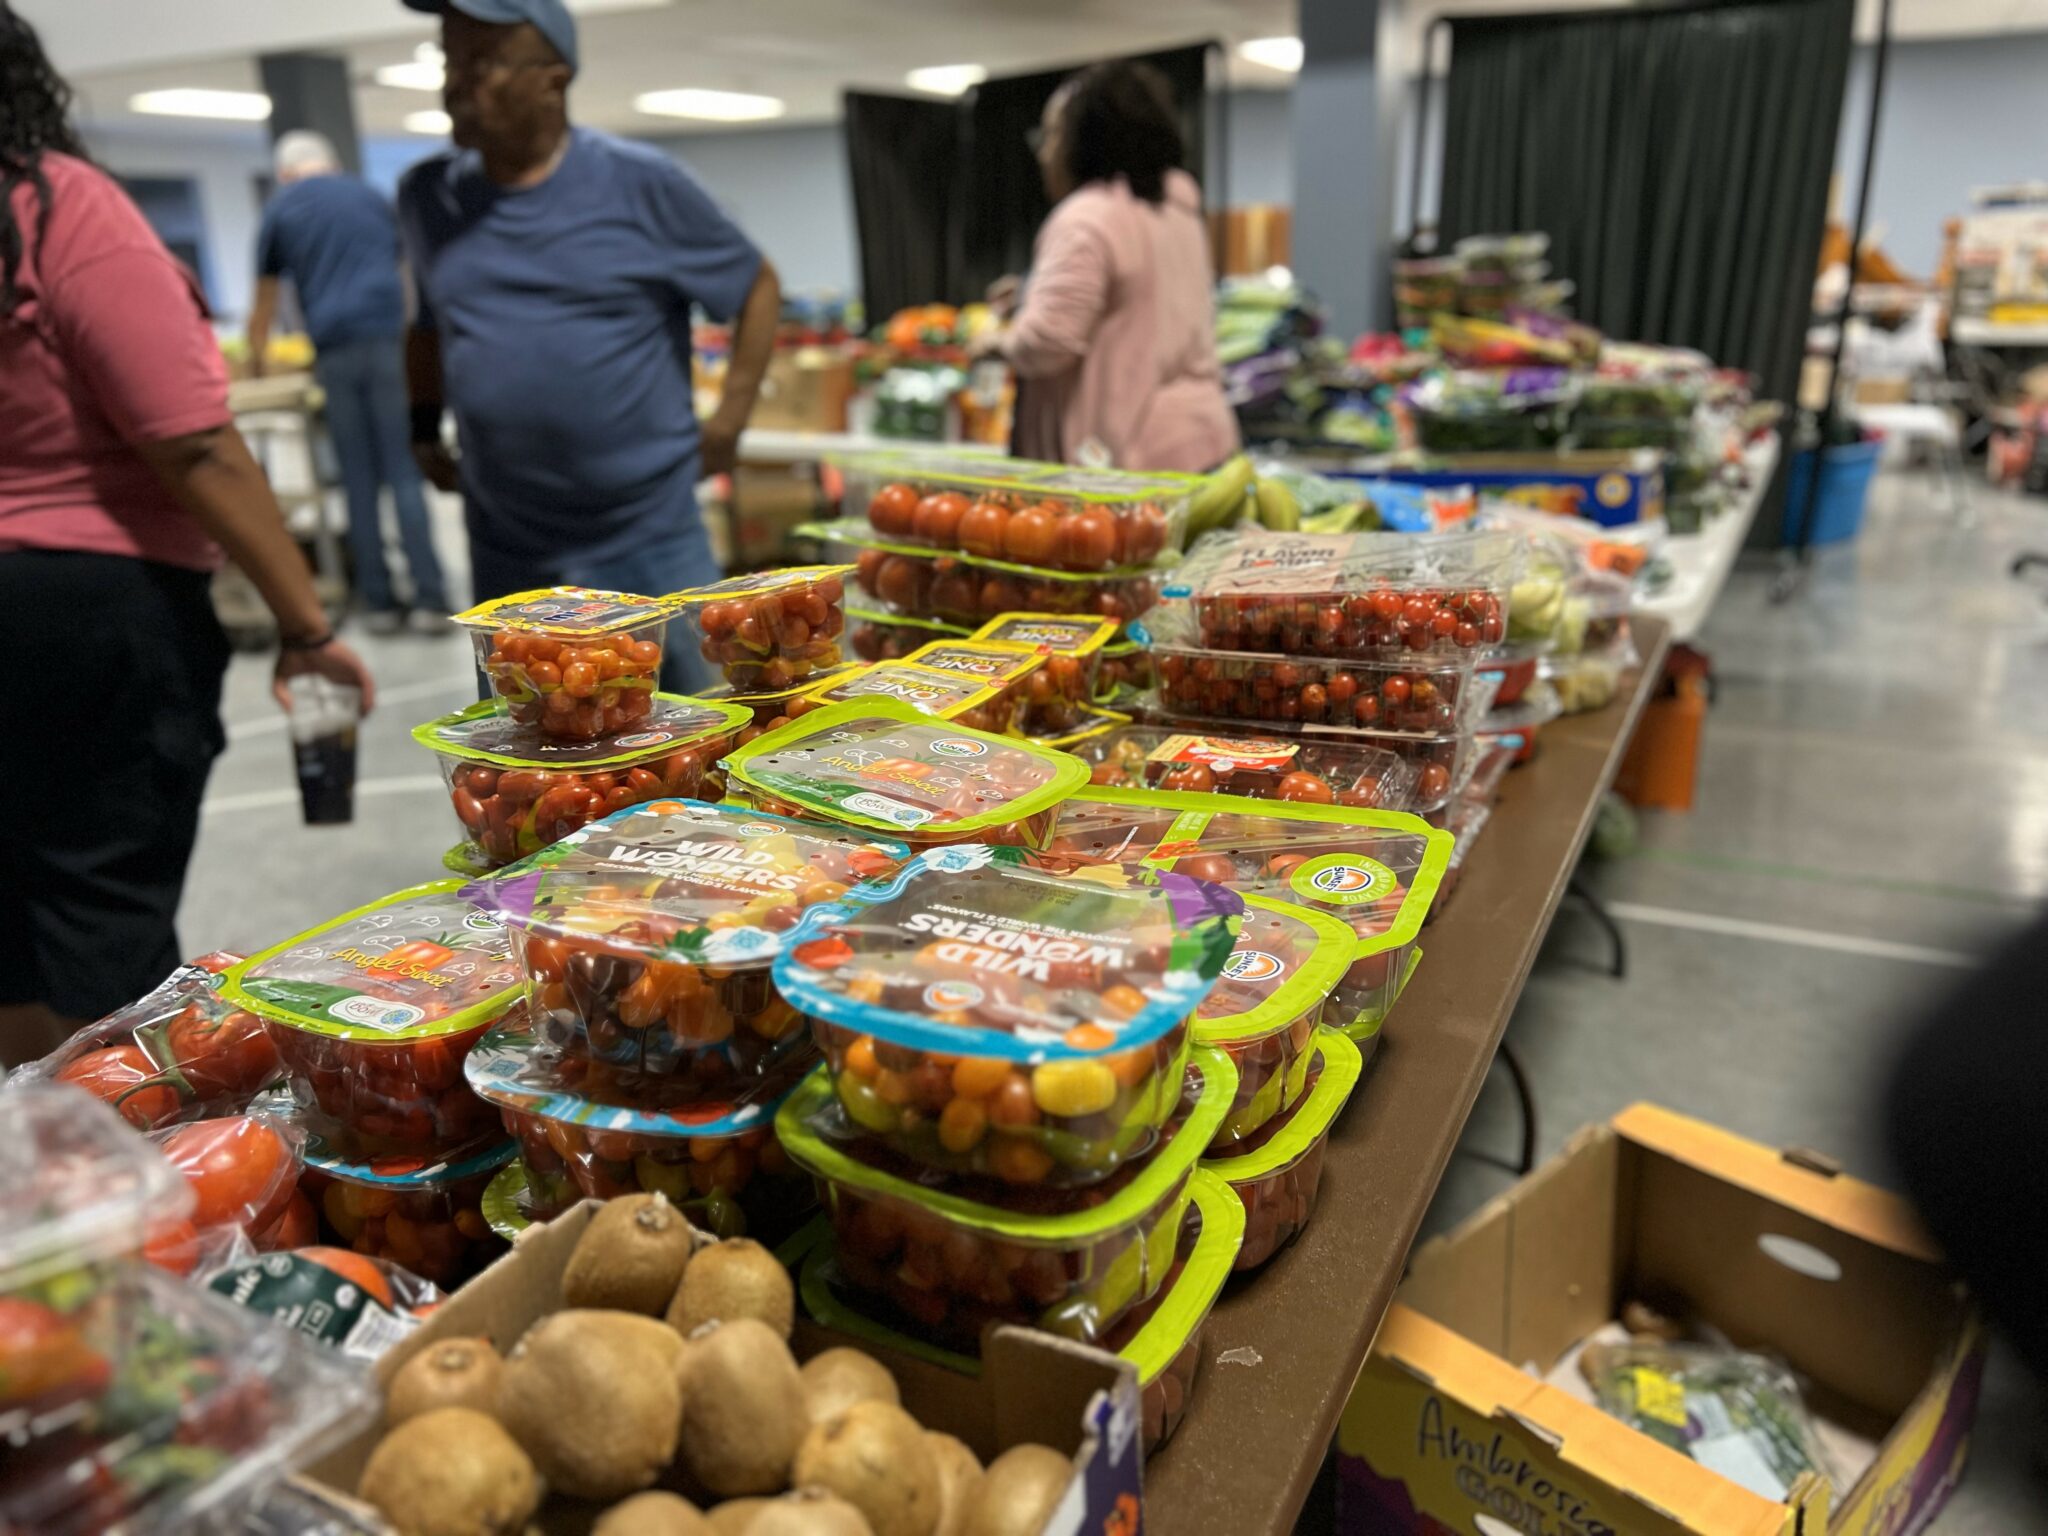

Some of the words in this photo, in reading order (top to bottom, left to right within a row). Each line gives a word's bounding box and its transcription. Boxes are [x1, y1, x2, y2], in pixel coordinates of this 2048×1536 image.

[932, 660, 996, 674] ONE
[864, 681, 939, 701] ONE
[818, 756, 888, 775] Angel
[889, 771, 948, 796] Sweet
[607, 845, 804, 890] WONDERS
[676, 840, 774, 866] WILD
[1323, 866, 1345, 892] SUNSET
[903, 913, 1125, 968] WONDERS
[328, 947, 406, 971] Angel
[399, 963, 456, 988] Sweet
[936, 943, 1050, 982] WILD
[1226, 951, 1257, 978] SUNSET
[1418, 1395, 1616, 1536] Ambrosia
